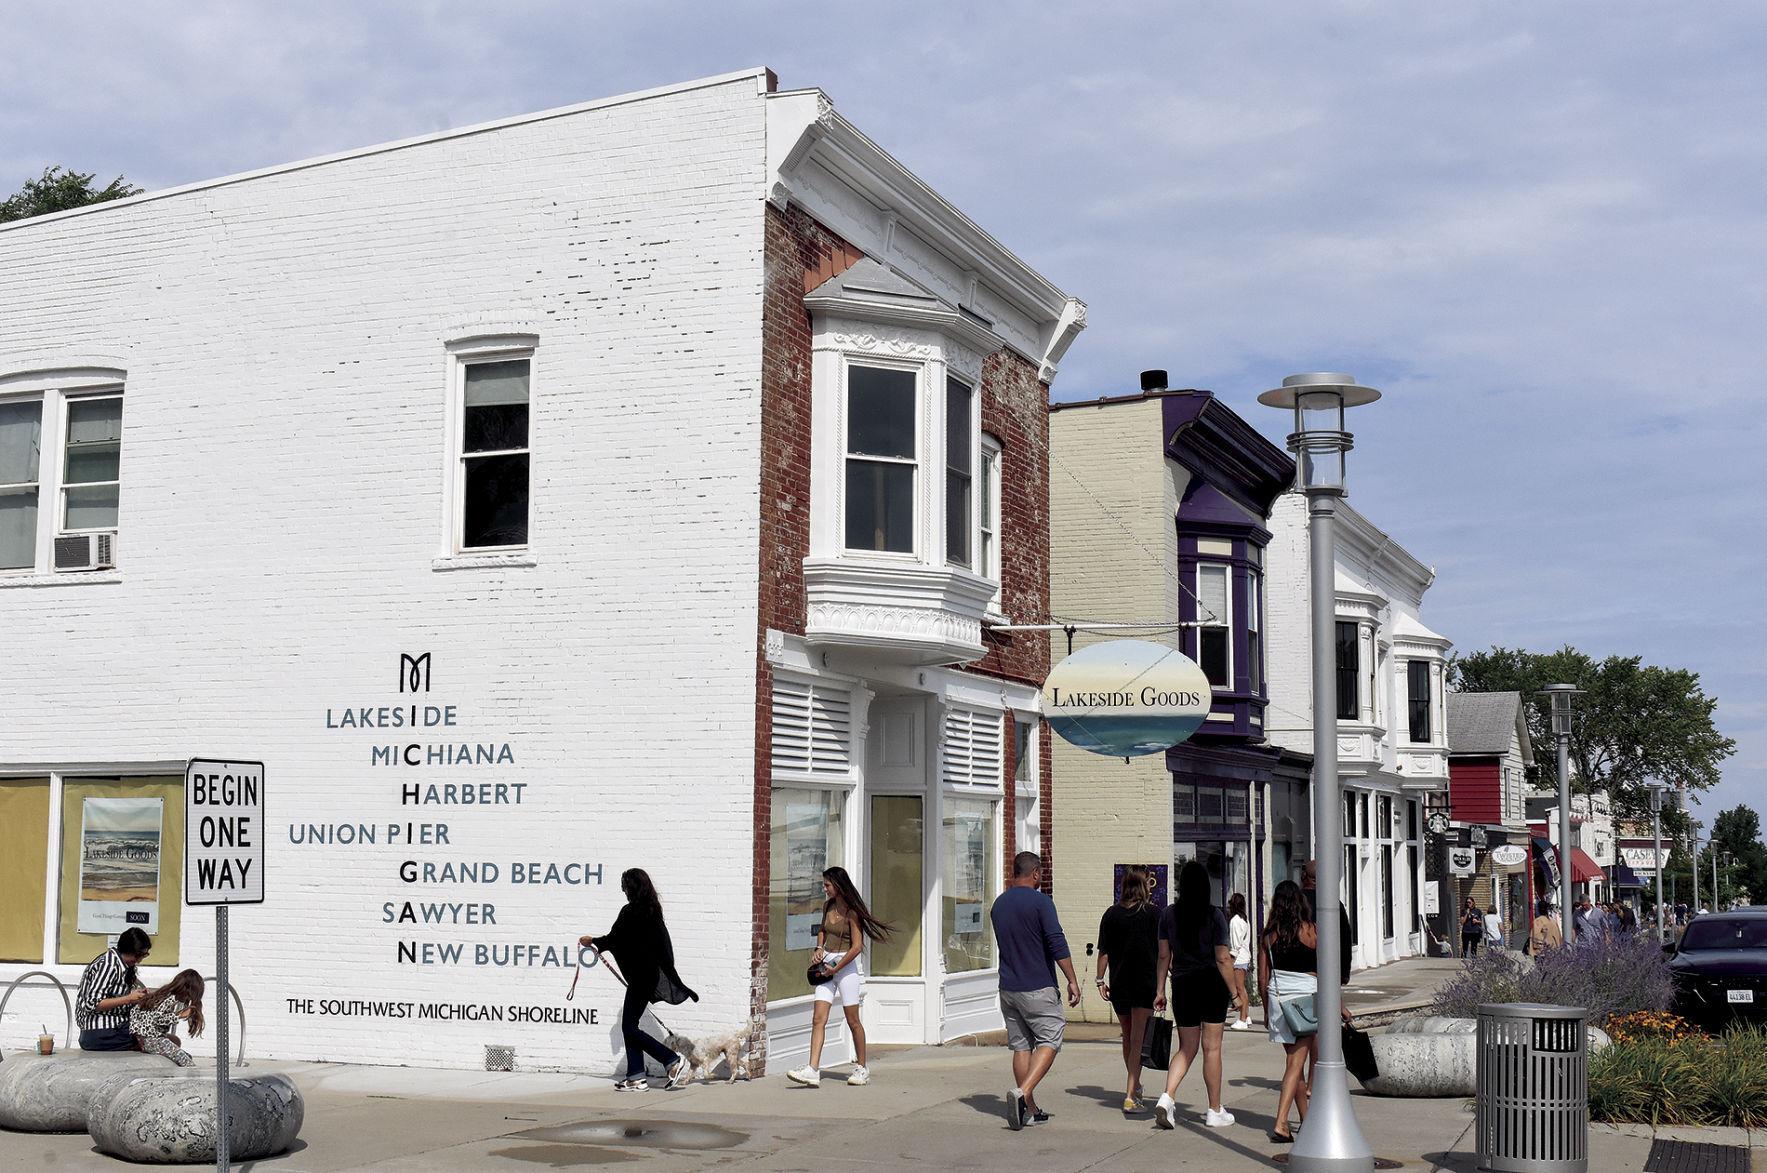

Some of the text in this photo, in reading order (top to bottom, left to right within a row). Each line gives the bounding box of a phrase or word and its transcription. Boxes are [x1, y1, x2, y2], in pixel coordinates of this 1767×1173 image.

[1140, 686, 1200, 708] GOODS
[326, 704, 457, 728] LAKESIDE
[371, 743, 515, 767] MICHIANA
[193, 773, 258, 807] BEGIN
[401, 783, 528, 806] HARBERT
[199, 815, 251, 848] ONE
[289, 822, 450, 845] UNION PIER
[197, 858, 253, 890] WAY
[399, 860, 603, 886] GRAND BEACH
[382, 901, 497, 925] SAWYER
[397, 940, 599, 969] NEW BUFFALO
[286, 998, 599, 1025] THE SOUTHWEST MICHIGAN SHORELINE
